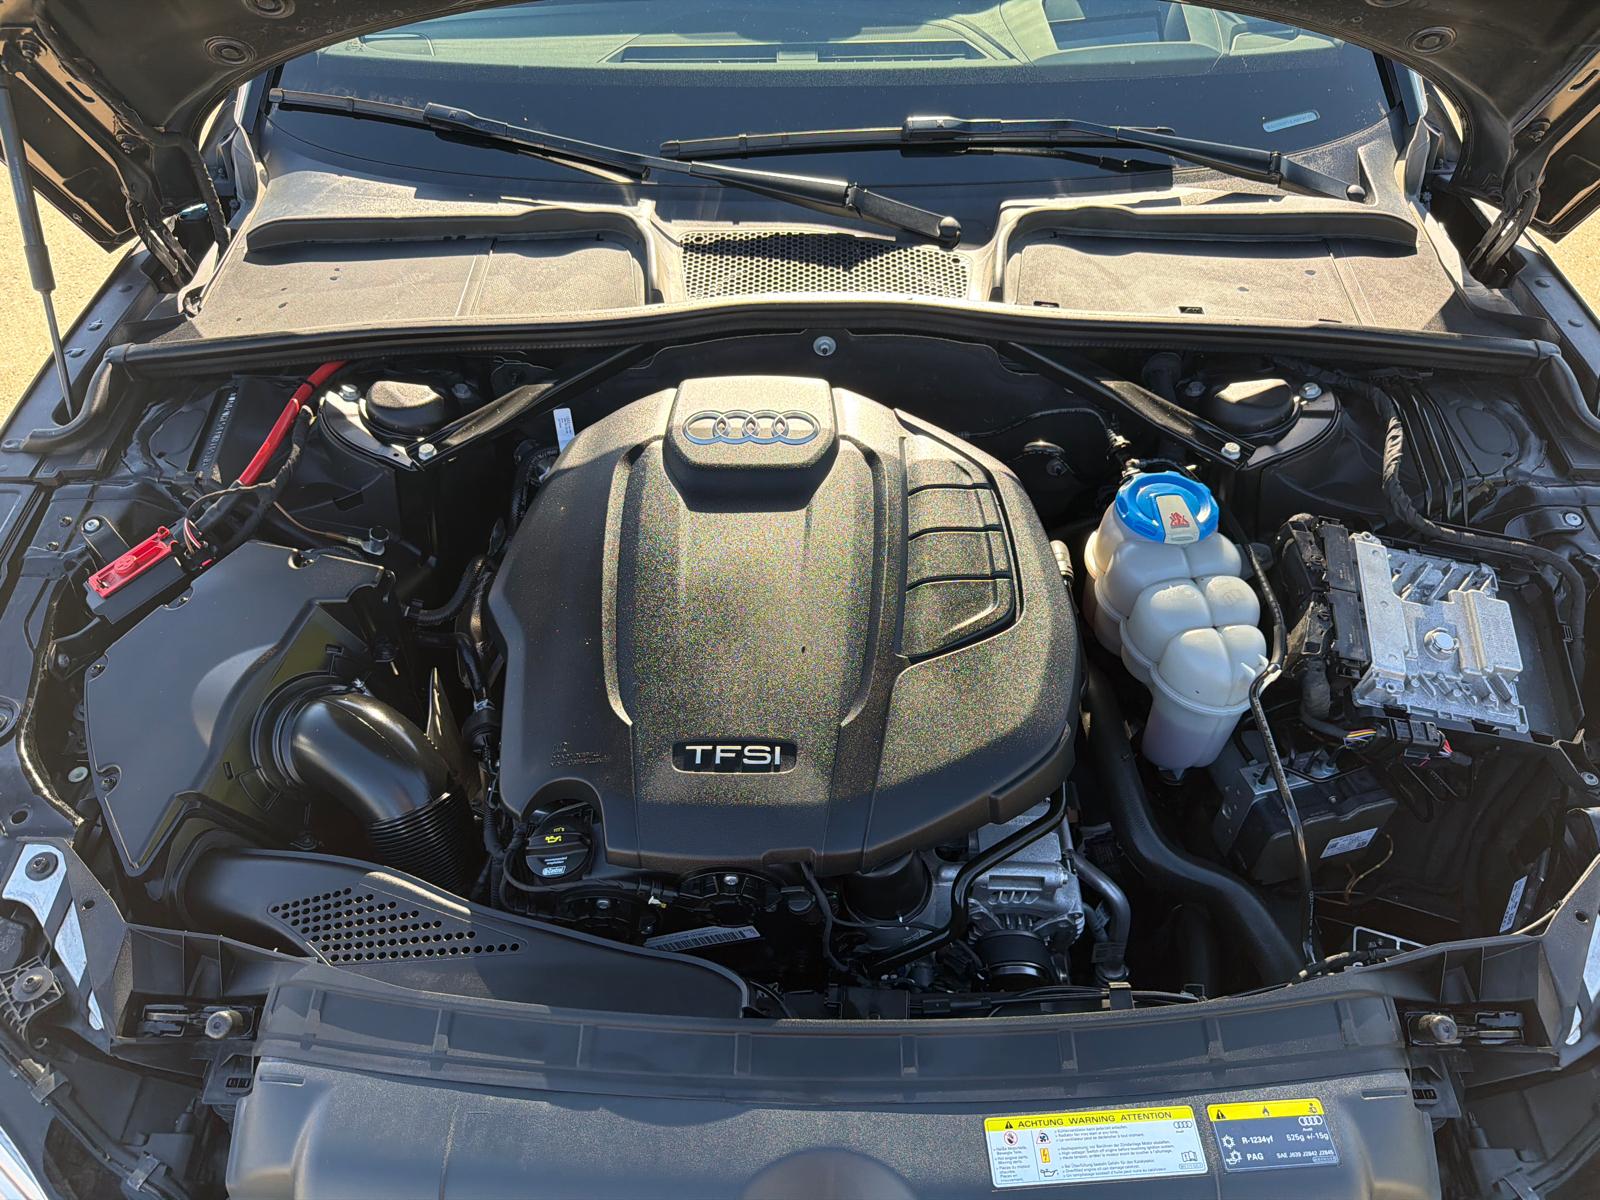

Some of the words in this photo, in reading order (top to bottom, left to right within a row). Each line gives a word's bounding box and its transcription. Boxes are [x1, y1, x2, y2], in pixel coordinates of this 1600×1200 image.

[686, 746, 780, 765] TFSI
[1018, 1118, 1064, 1128] ACHTUNG
[1068, 1115, 1115, 1124] WARNING
[1121, 1112, 1172, 1120] ATTENTION
[1241, 1135, 1273, 1144] R-1234yf
[1286, 1134, 1305, 1142] 525g
[1306, 1132, 1329, 1140] +/-15g
[1246, 1152, 1264, 1160] PAG
